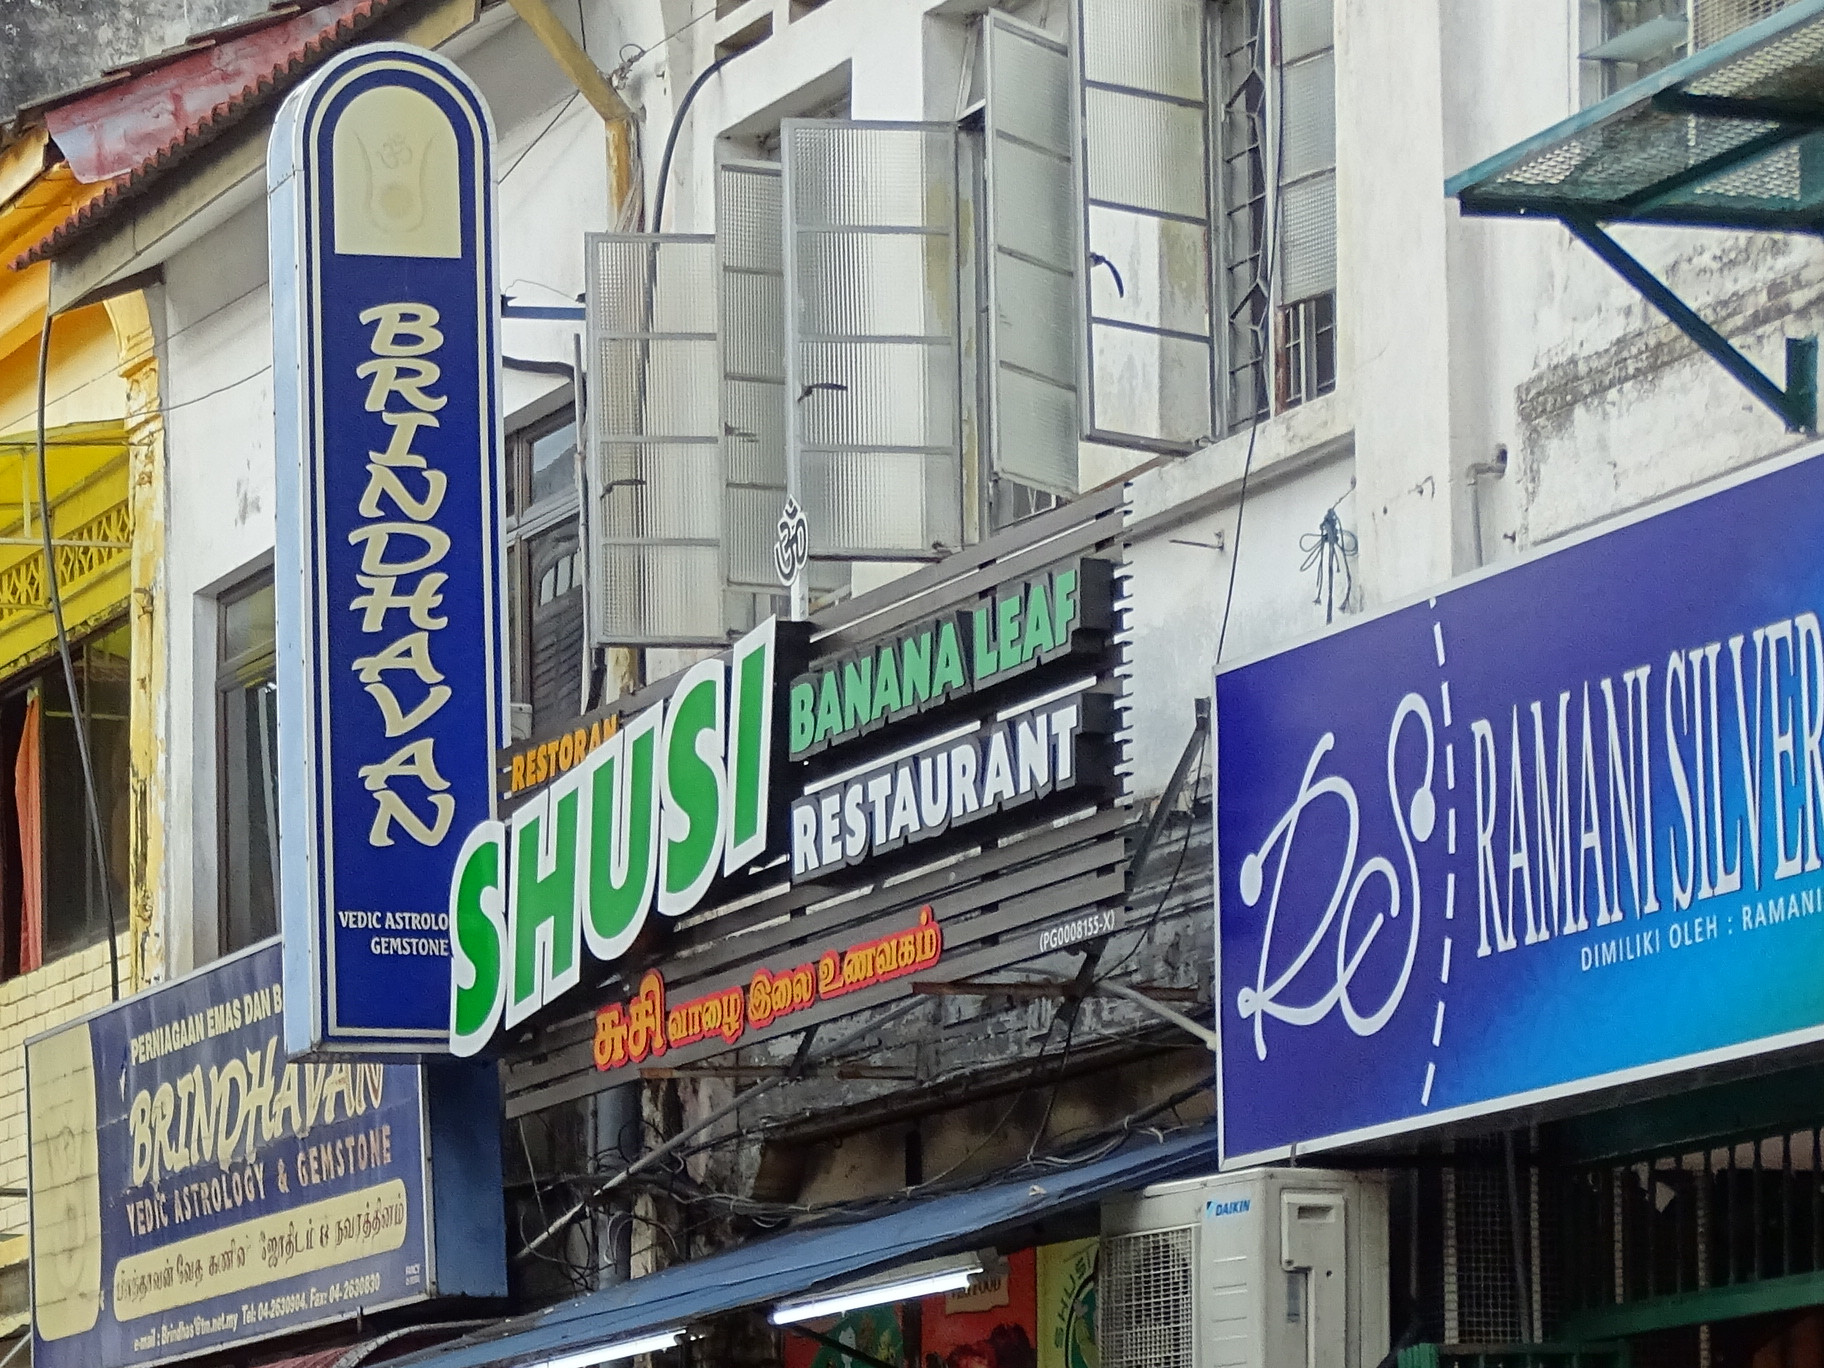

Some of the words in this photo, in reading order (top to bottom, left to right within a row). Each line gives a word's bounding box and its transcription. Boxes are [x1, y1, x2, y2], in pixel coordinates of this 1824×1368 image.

[348, 301, 456, 848] BRINDHAVAN
[790, 618, 966, 754] BANANA
[975, 570, 1079, 679] LEAF
[451, 615, 776, 1056] SHUSI
[792, 705, 1080, 876] RESTAURANT
[1472, 664, 1663, 959] RAMANI
[338, 910, 382, 929] VEDIC
[370, 937, 449, 956] GEMSTONE
[1039, 909, 1116, 953] (PG0008155-X)
[1581, 928, 1661, 972] DIMILIKI
[1669, 913, 1718, 949] OLEH
[1742, 887, 1823, 931] RAMANI
[130, 1010, 205, 1067] PERNIAGAAN
[206, 998, 242, 1036] EMAS
[243, 987, 271, 1025] DAN
[594, 967, 667, 1071] சுசி
[747, 962, 817, 1029] இலை
[818, 904, 944, 999] உணவகம்
[129, 1035, 385, 1188] BRINDHAVAN
[126, 1186, 168, 1238] VEDIC
[174, 1162, 267, 1226] ASTROLOGY
[296, 1124, 392, 1188] GEMSTONE
[1216, 1200, 1251, 1216] DAIKIN
